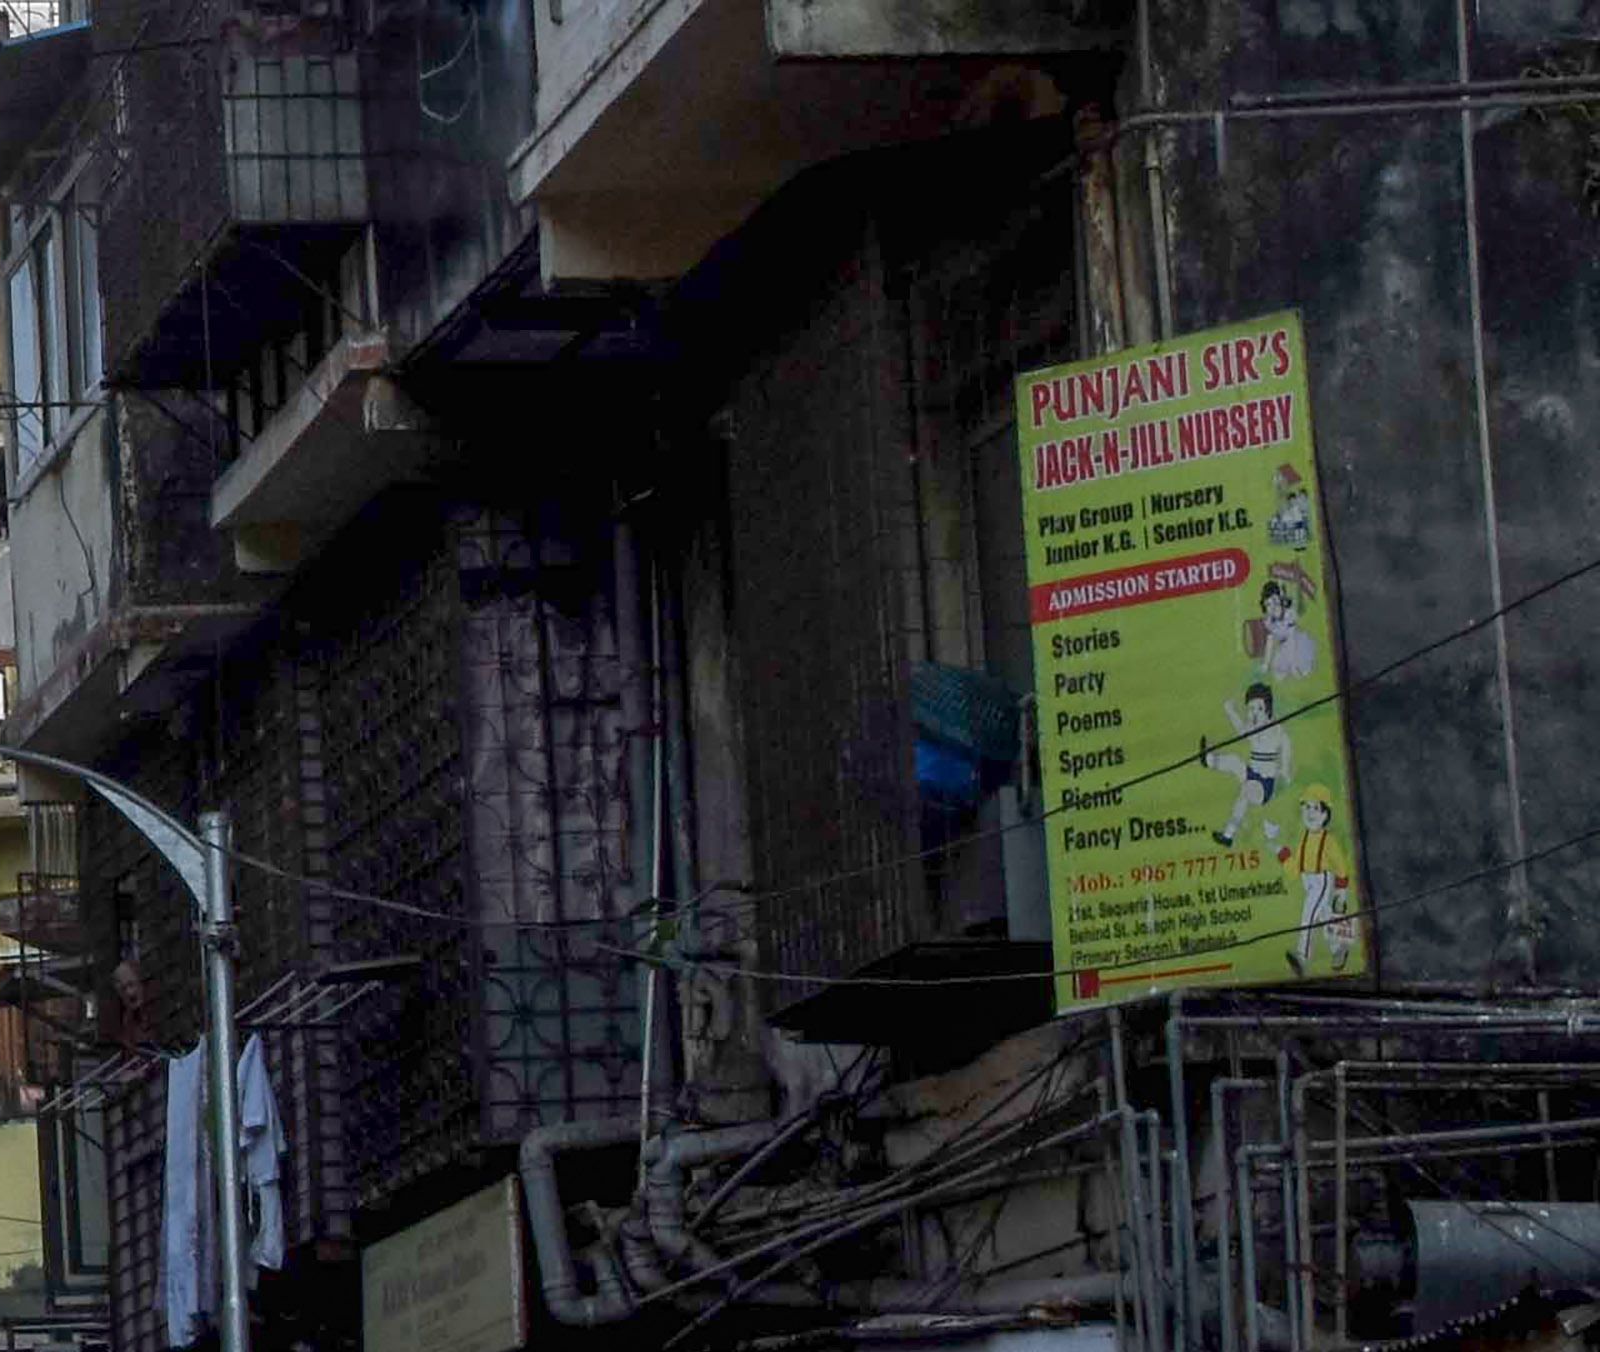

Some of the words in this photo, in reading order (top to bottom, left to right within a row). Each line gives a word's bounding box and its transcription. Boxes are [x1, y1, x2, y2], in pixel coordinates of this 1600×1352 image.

[1031, 353, 1188, 426] PUNJANI
[1203, 331, 1290, 391] SIR'S
[1036, 420, 1174, 490] JACK-N-JILL
[1178, 395, 1292, 459] NURSERY
[1038, 513, 1075, 537] Play
[1080, 502, 1133, 528] Group
[1151, 484, 1224, 514] Nursery
[1044, 540, 1098, 566] Junior
[1102, 530, 1137, 554] K.G.
[1153, 518, 1214, 545] Senior
[1218, 508, 1253, 532] K.G.
[1048, 574, 1150, 612] ADMISSION
[1154, 559, 1236, 590] STARTED
[1052, 627, 1121, 659] Stories
[1055, 672, 1105, 697] Party
[1057, 708, 1123, 736] Poems
[1059, 747, 1125, 778] Sports
[1061, 782, 1124, 812] Picnic
[1063, 827, 1122, 852] Fancy
[1129, 816, 1206, 843] Dress...
[1184, 856, 1219, 878] 777
[1226, 850, 1260, 872] 715
[1209, 905, 1252, 926] School
